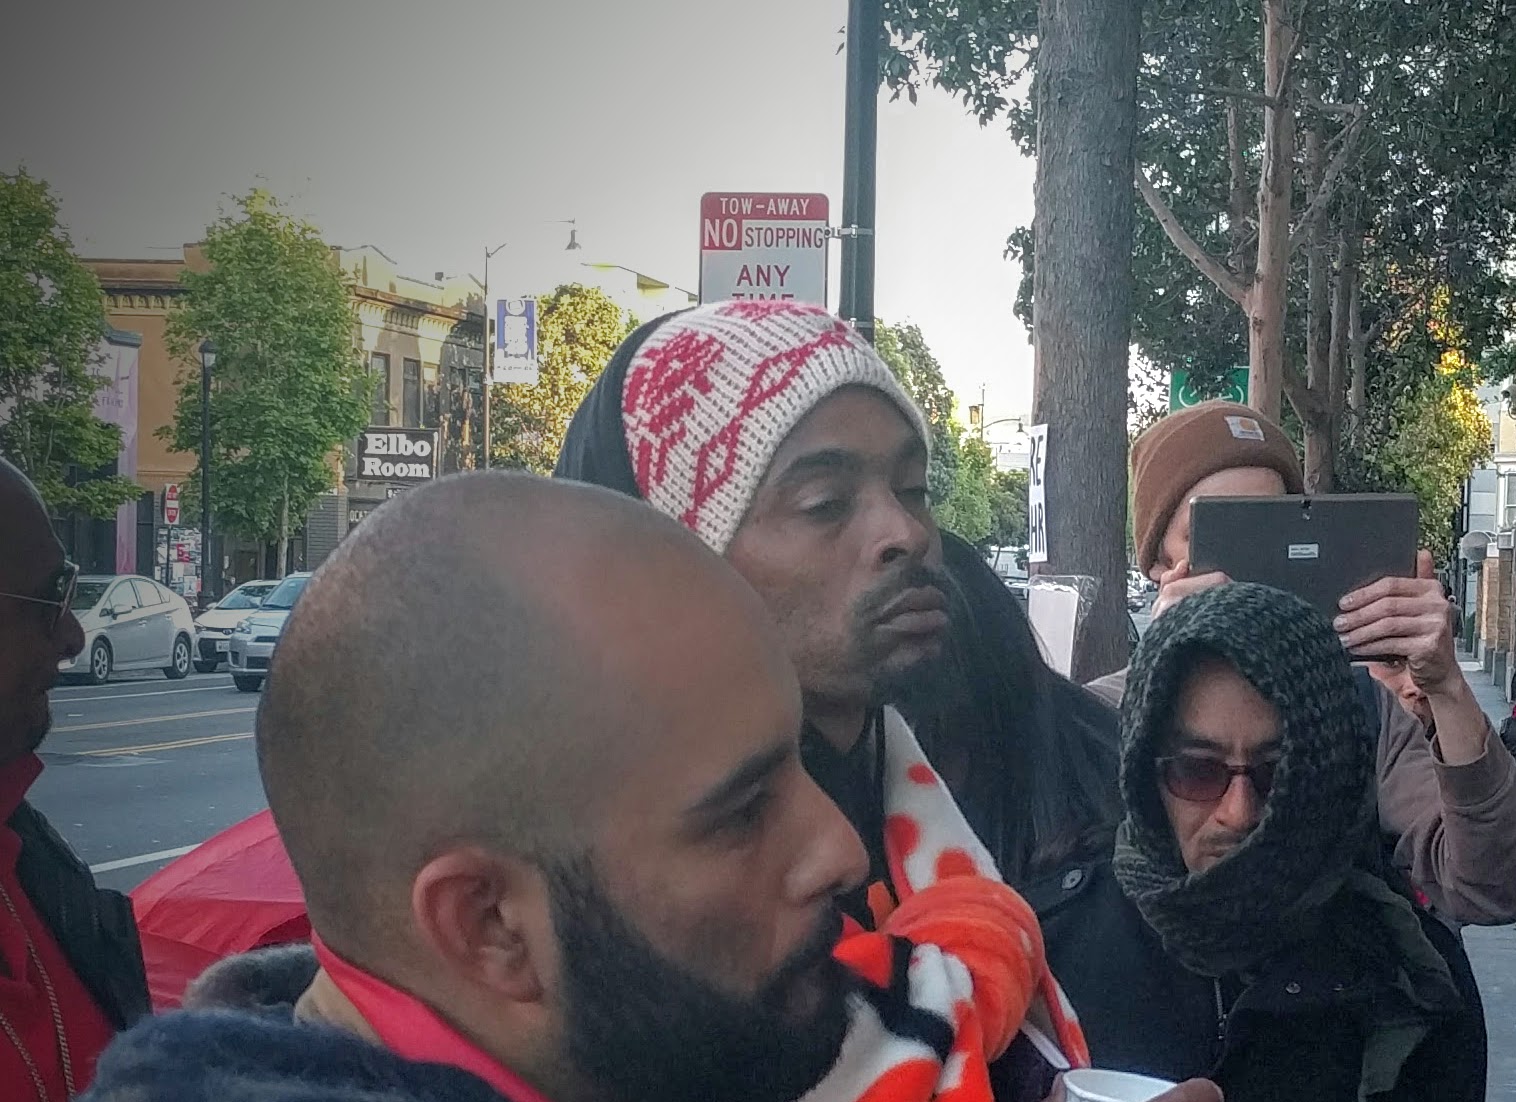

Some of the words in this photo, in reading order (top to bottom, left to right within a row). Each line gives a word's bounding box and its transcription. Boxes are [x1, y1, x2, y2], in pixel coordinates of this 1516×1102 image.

[719, 197, 810, 216] TOW-AWAY
[704, 218, 739, 248] NO
[744, 226, 824, 249] STOPPING
[736, 264, 790, 287] ANY
[364, 433, 432, 457] Elbo
[362, 456, 431, 478] Room
